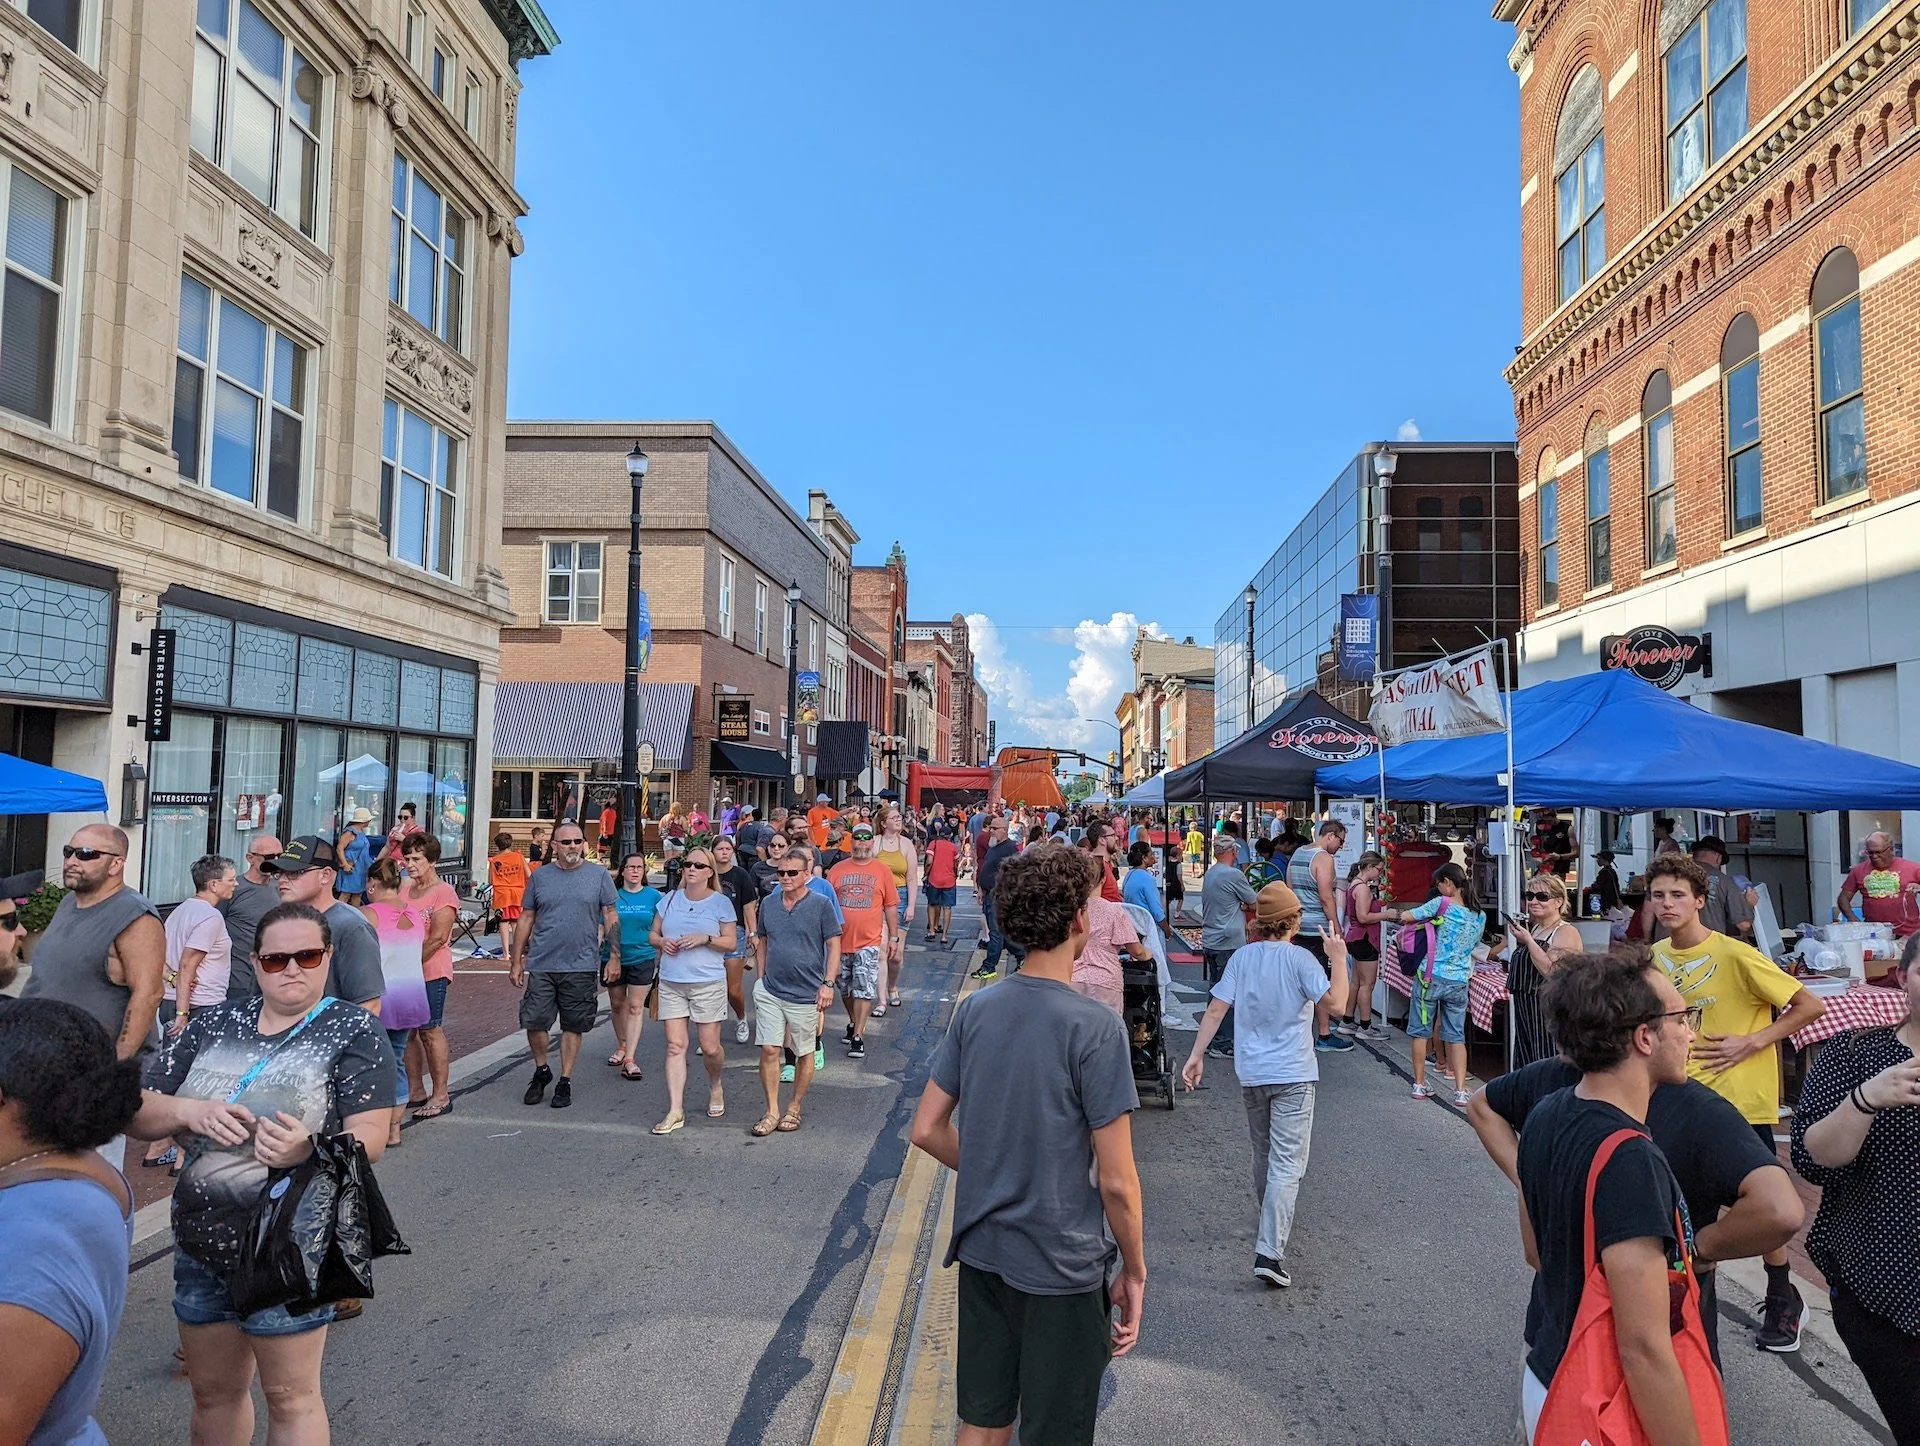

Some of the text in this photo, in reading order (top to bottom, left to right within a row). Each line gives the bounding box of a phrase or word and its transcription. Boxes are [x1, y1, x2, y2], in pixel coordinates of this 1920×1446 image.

[1639, 630, 1663, 639] TOYS
[1606, 638, 1698, 669] Forever
[1659, 662, 1682, 687] HOBBIES
[153, 635, 167, 726] INTERSECTION
[720, 721, 748, 729] STEAK
[1306, 719, 1337, 727] TOYS
[720, 729, 748, 737] HOUSE
[1268, 727, 1379, 749] Forever
[152, 794, 208, 803] INTERSECTION
